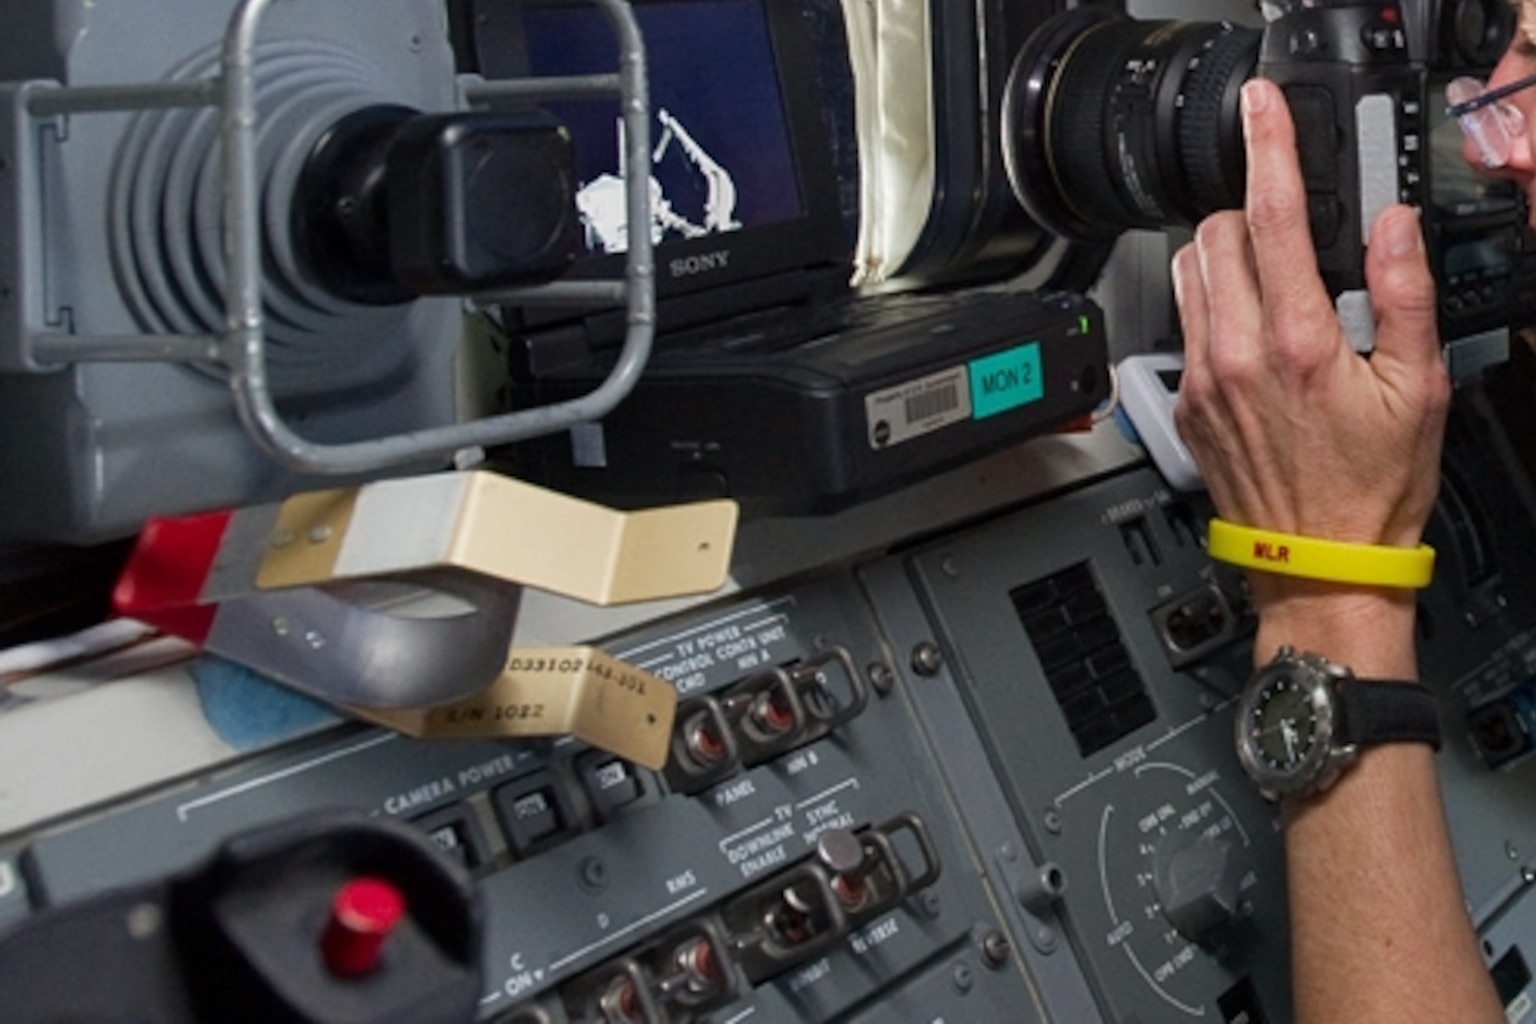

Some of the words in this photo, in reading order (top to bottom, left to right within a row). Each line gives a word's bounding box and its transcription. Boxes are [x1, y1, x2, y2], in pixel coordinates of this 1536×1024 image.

[669, 250, 730, 277] SONY
[982, 367, 1019, 394] MON
[1022, 362, 1033, 385] 2
[676, 641, 694, 658] TV
[697, 626, 742, 650] POWER
[654, 653, 714, 679] CONTROL
[384, 777, 454, 814] CAMERA
[458, 754, 515, 787] POWER
[715, 779, 755, 808] PANEL
[774, 804, 793, 821] TV
[665, 869, 697, 894] RMS
[596, 912, 610, 929] D
[510, 952, 524, 971] C
[505, 971, 533, 996] ON
